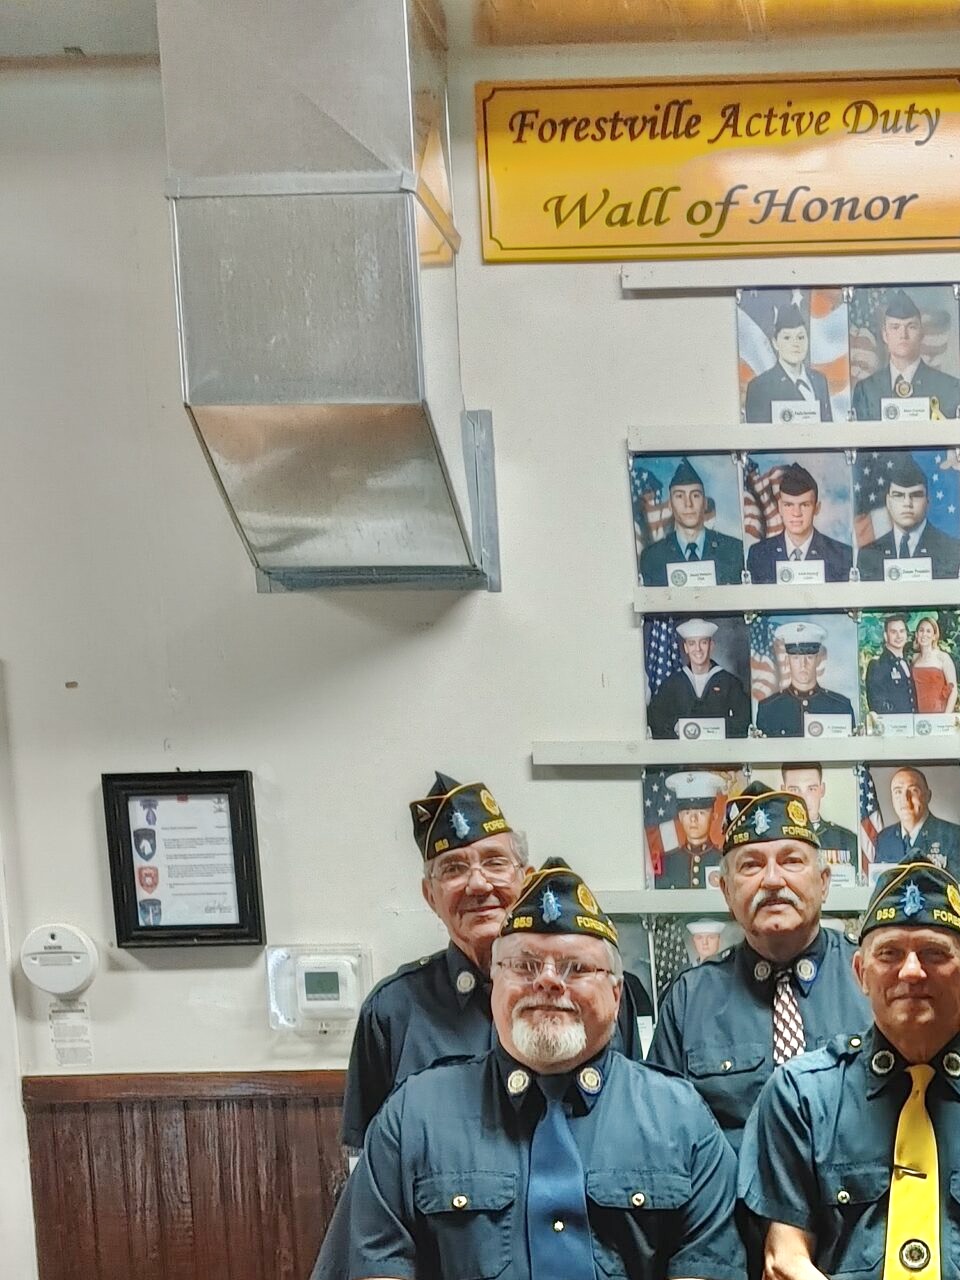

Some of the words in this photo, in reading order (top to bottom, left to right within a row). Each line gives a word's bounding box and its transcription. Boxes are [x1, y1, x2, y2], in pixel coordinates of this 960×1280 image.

[508, 98, 701, 144] Forestville
[707, 100, 831, 144] Active
[842, 99, 941, 146] Duty
[543, 186, 682, 230] Wall
[686, 184, 748, 239] of
[749, 185, 919, 225] Honor
[876, 907, 896, 921] 953
